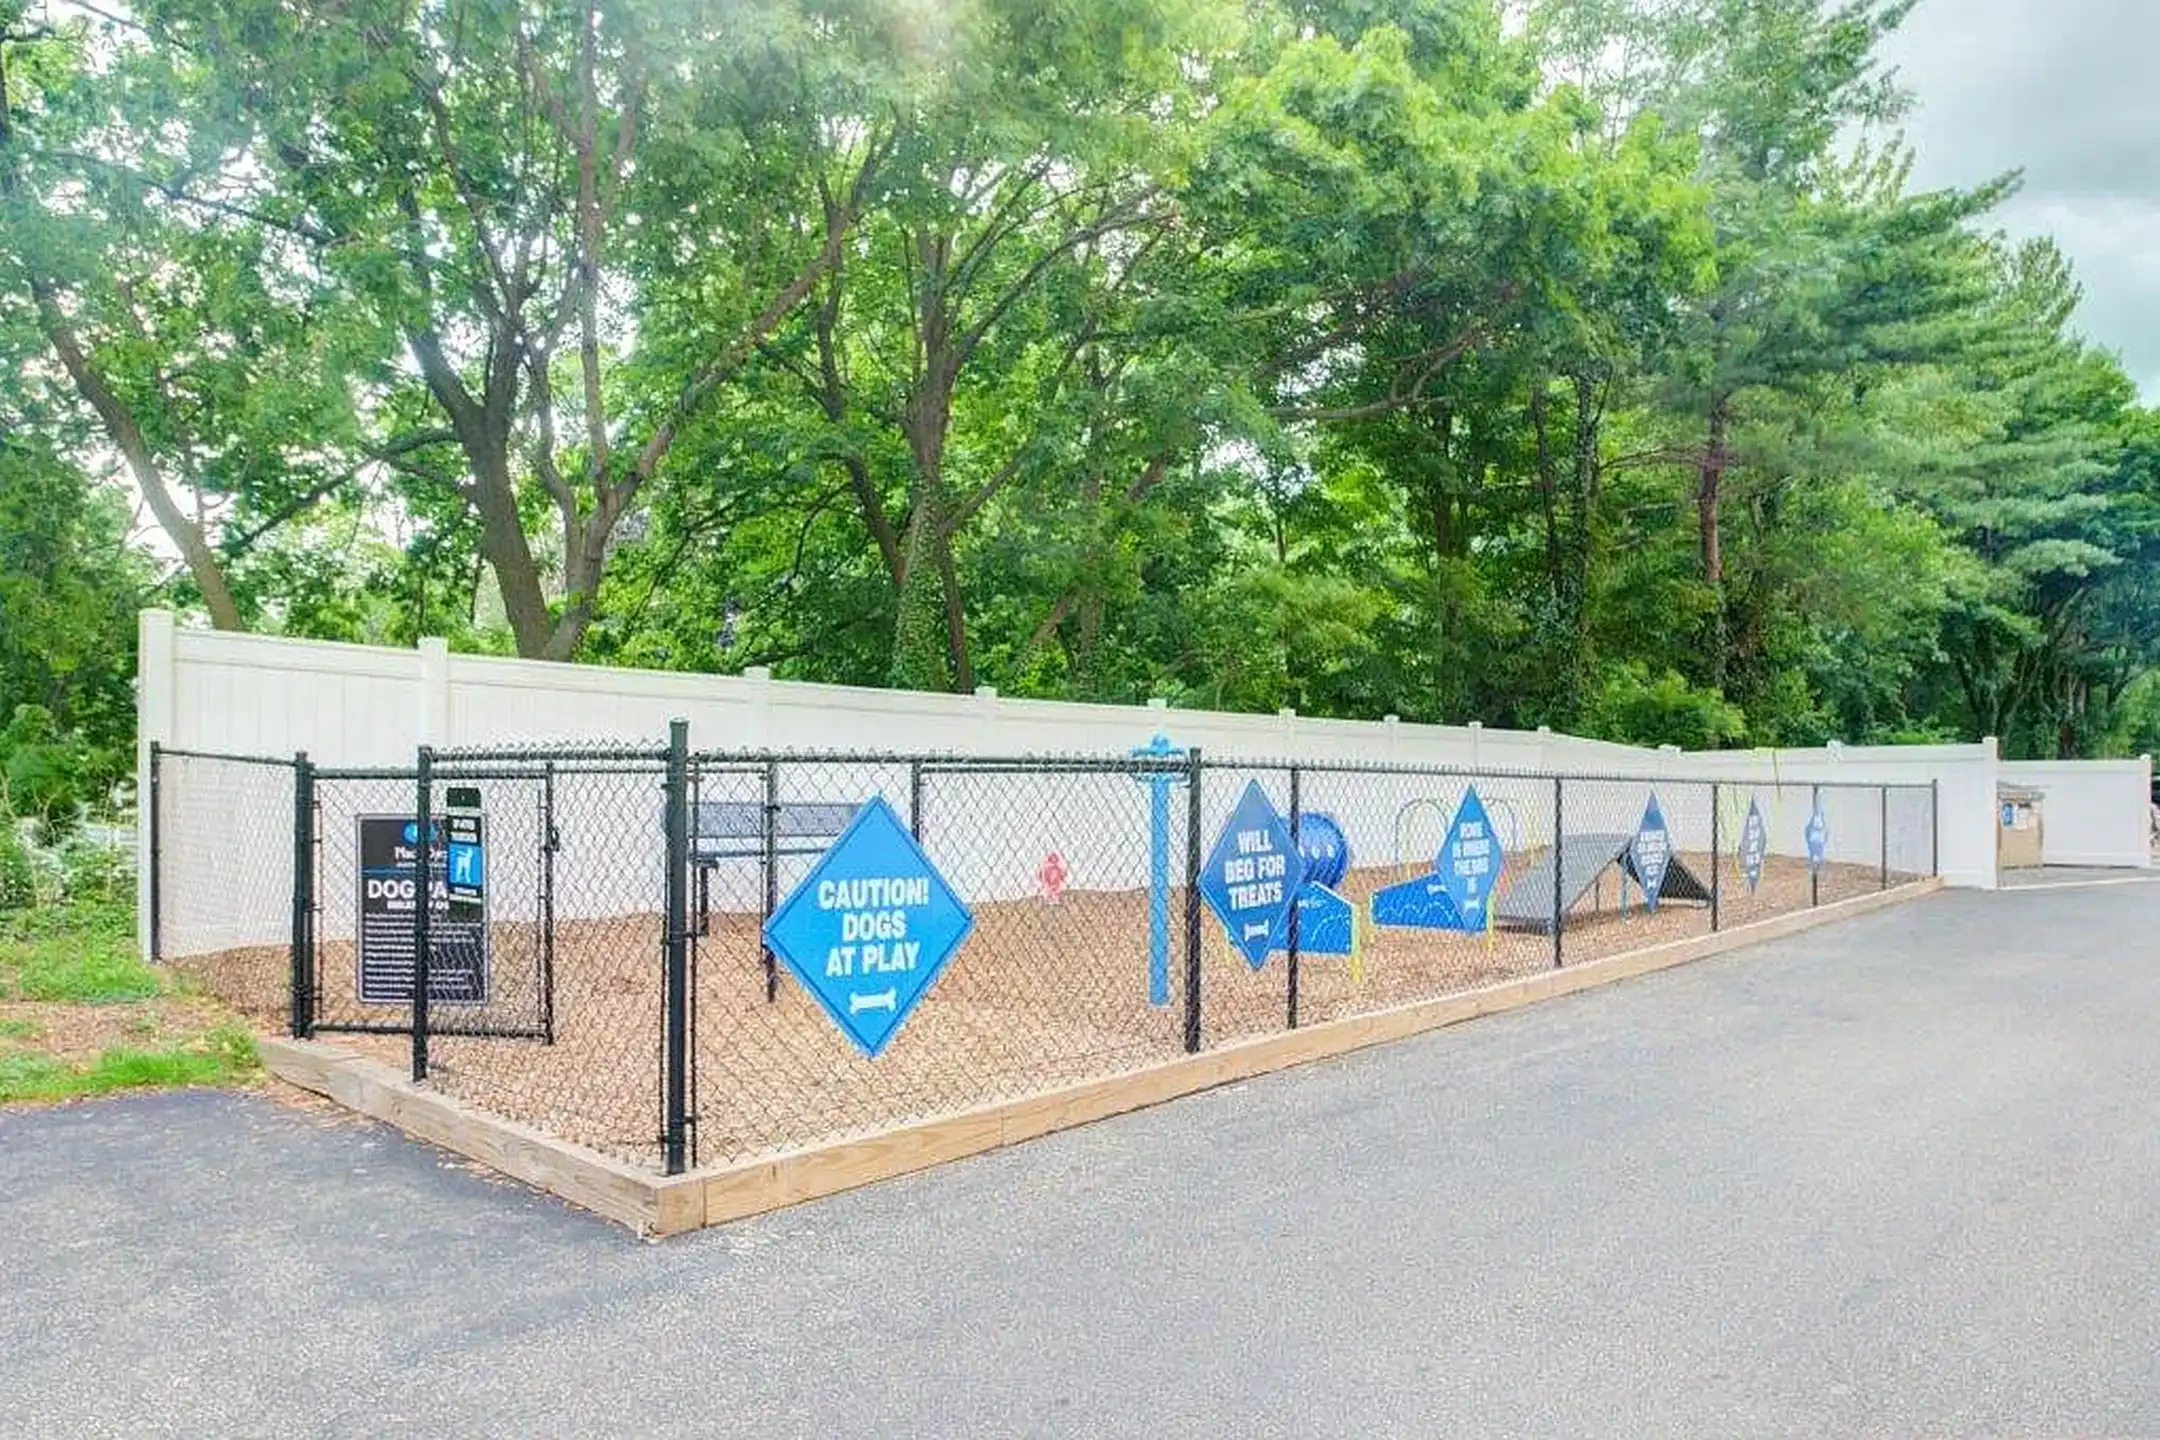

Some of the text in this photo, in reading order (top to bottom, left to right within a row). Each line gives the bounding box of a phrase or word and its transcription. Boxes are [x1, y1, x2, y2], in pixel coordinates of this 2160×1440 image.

[1238, 829, 1273, 855] WILL
[1259, 854, 1285, 879] FOR
[368, 880, 416, 899] DOG
[818, 878, 929, 910] CAUTION!
[1228, 881, 1284, 911] TREATS
[842, 910, 906, 942] DOGS
[825, 941, 920, 977] AT PLAY
